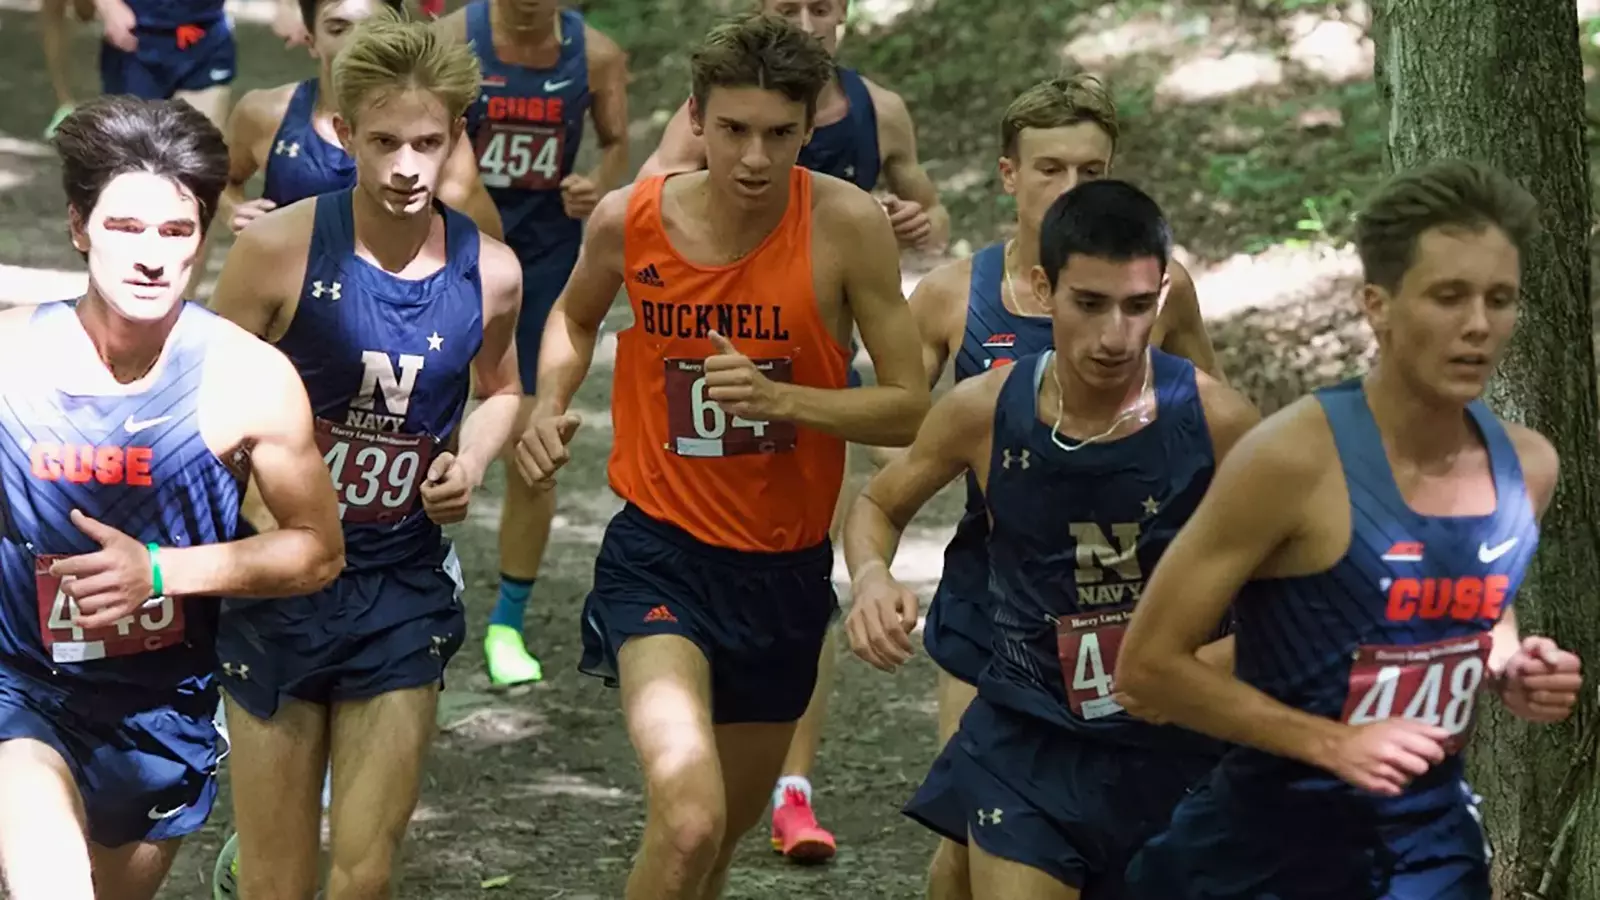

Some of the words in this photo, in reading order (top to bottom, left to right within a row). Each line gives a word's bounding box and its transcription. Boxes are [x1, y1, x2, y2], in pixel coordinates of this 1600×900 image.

[479, 132, 559, 180] 454
[641, 299, 789, 341] BUCKNELL
[345, 409, 406, 434] NAVY
[322, 441, 420, 508] 439
[1077, 581, 1143, 605] NAVY
[1348, 656, 1484, 736] 448
